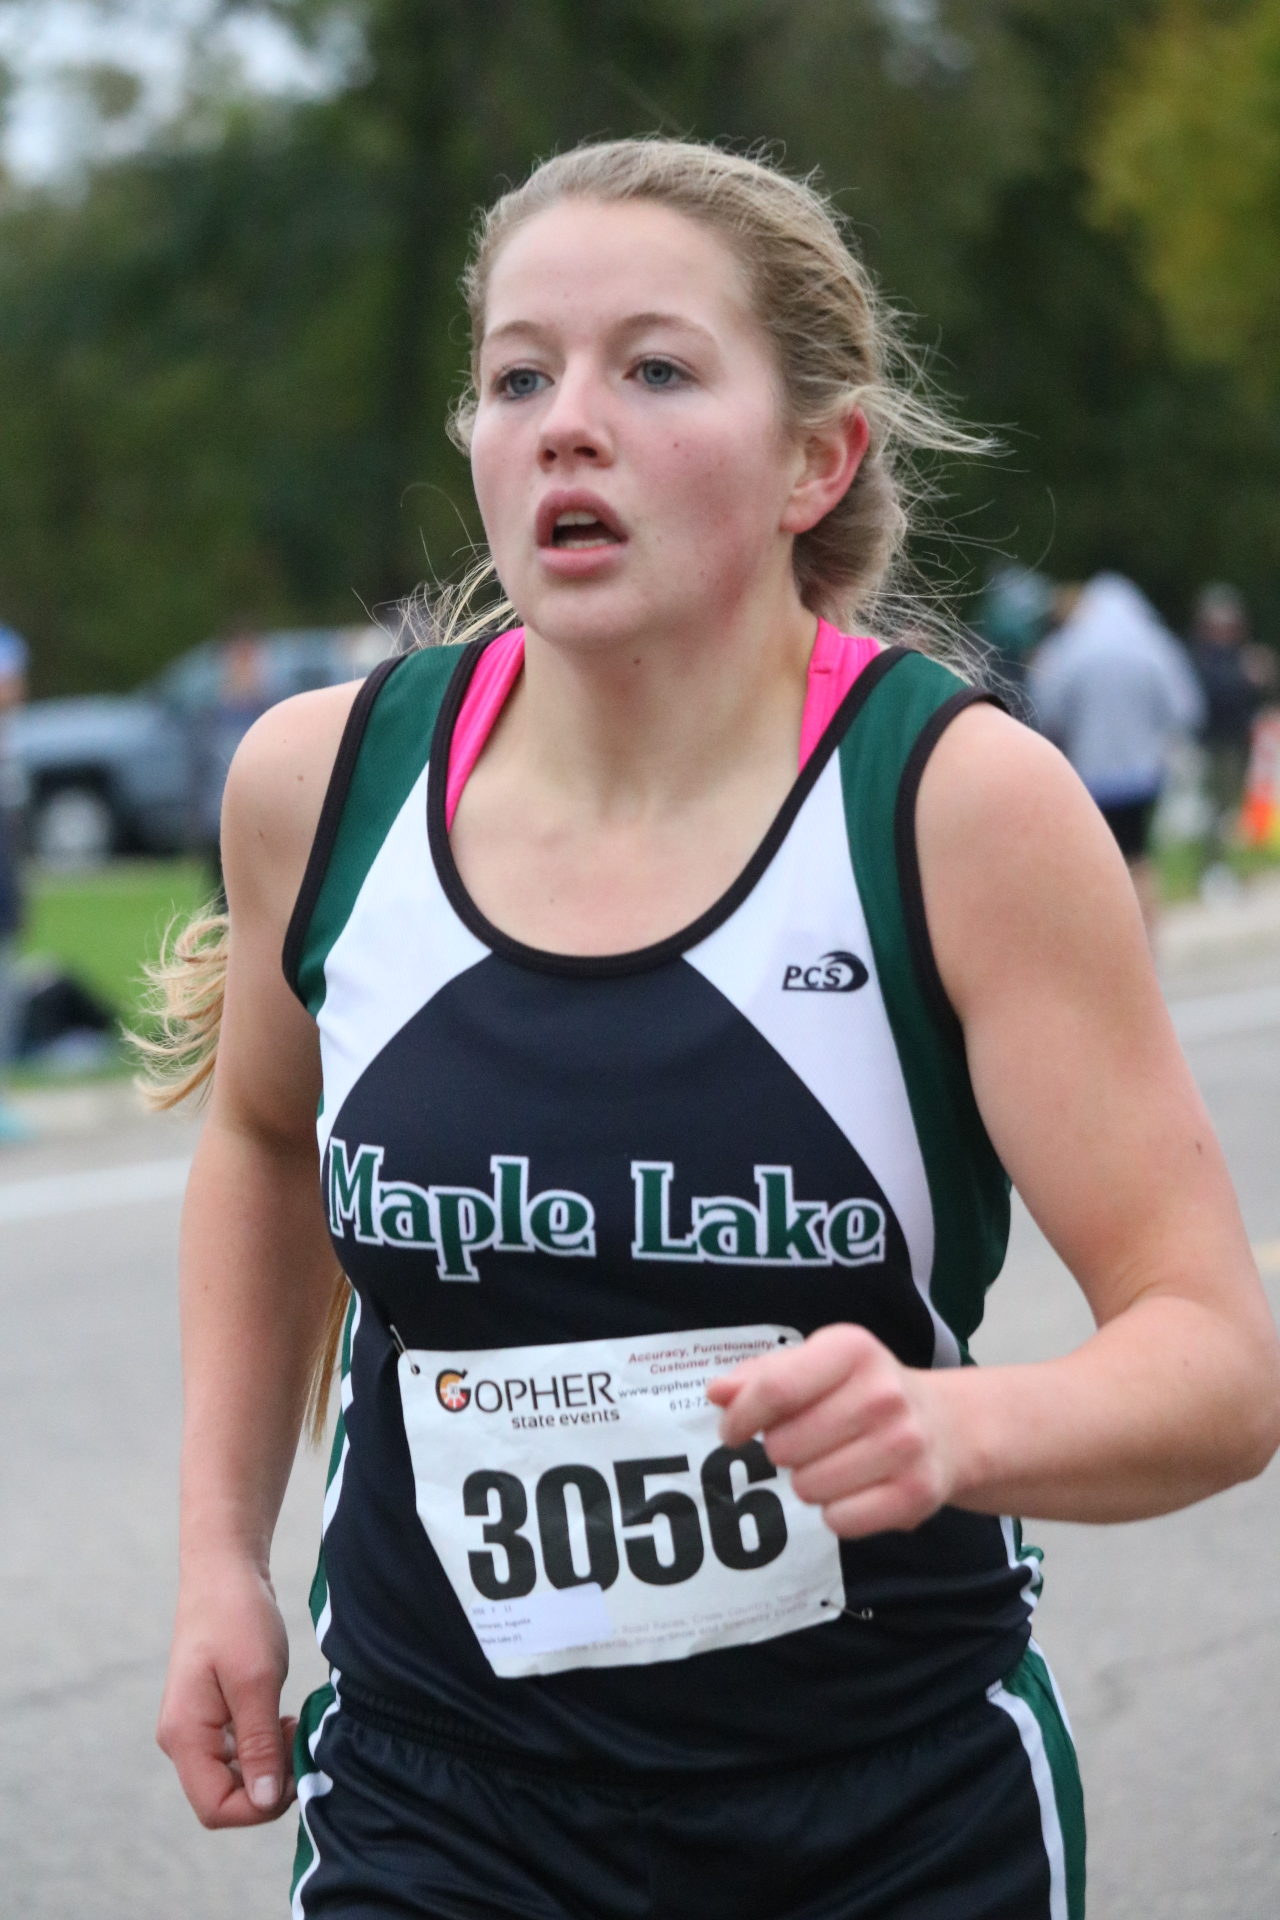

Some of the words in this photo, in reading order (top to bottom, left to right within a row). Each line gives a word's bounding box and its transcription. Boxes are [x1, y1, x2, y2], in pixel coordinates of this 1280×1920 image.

[329, 1137, 596, 1282] Maple
[631, 1161, 886, 1266] Lake
[650, 1360, 710, 1375] Customer
[435, 1368, 616, 1414] GOPHER
[512, 1414, 555, 1430] state
[559, 1408, 621, 1428] events
[462, 1439, 788, 1601] 3056
